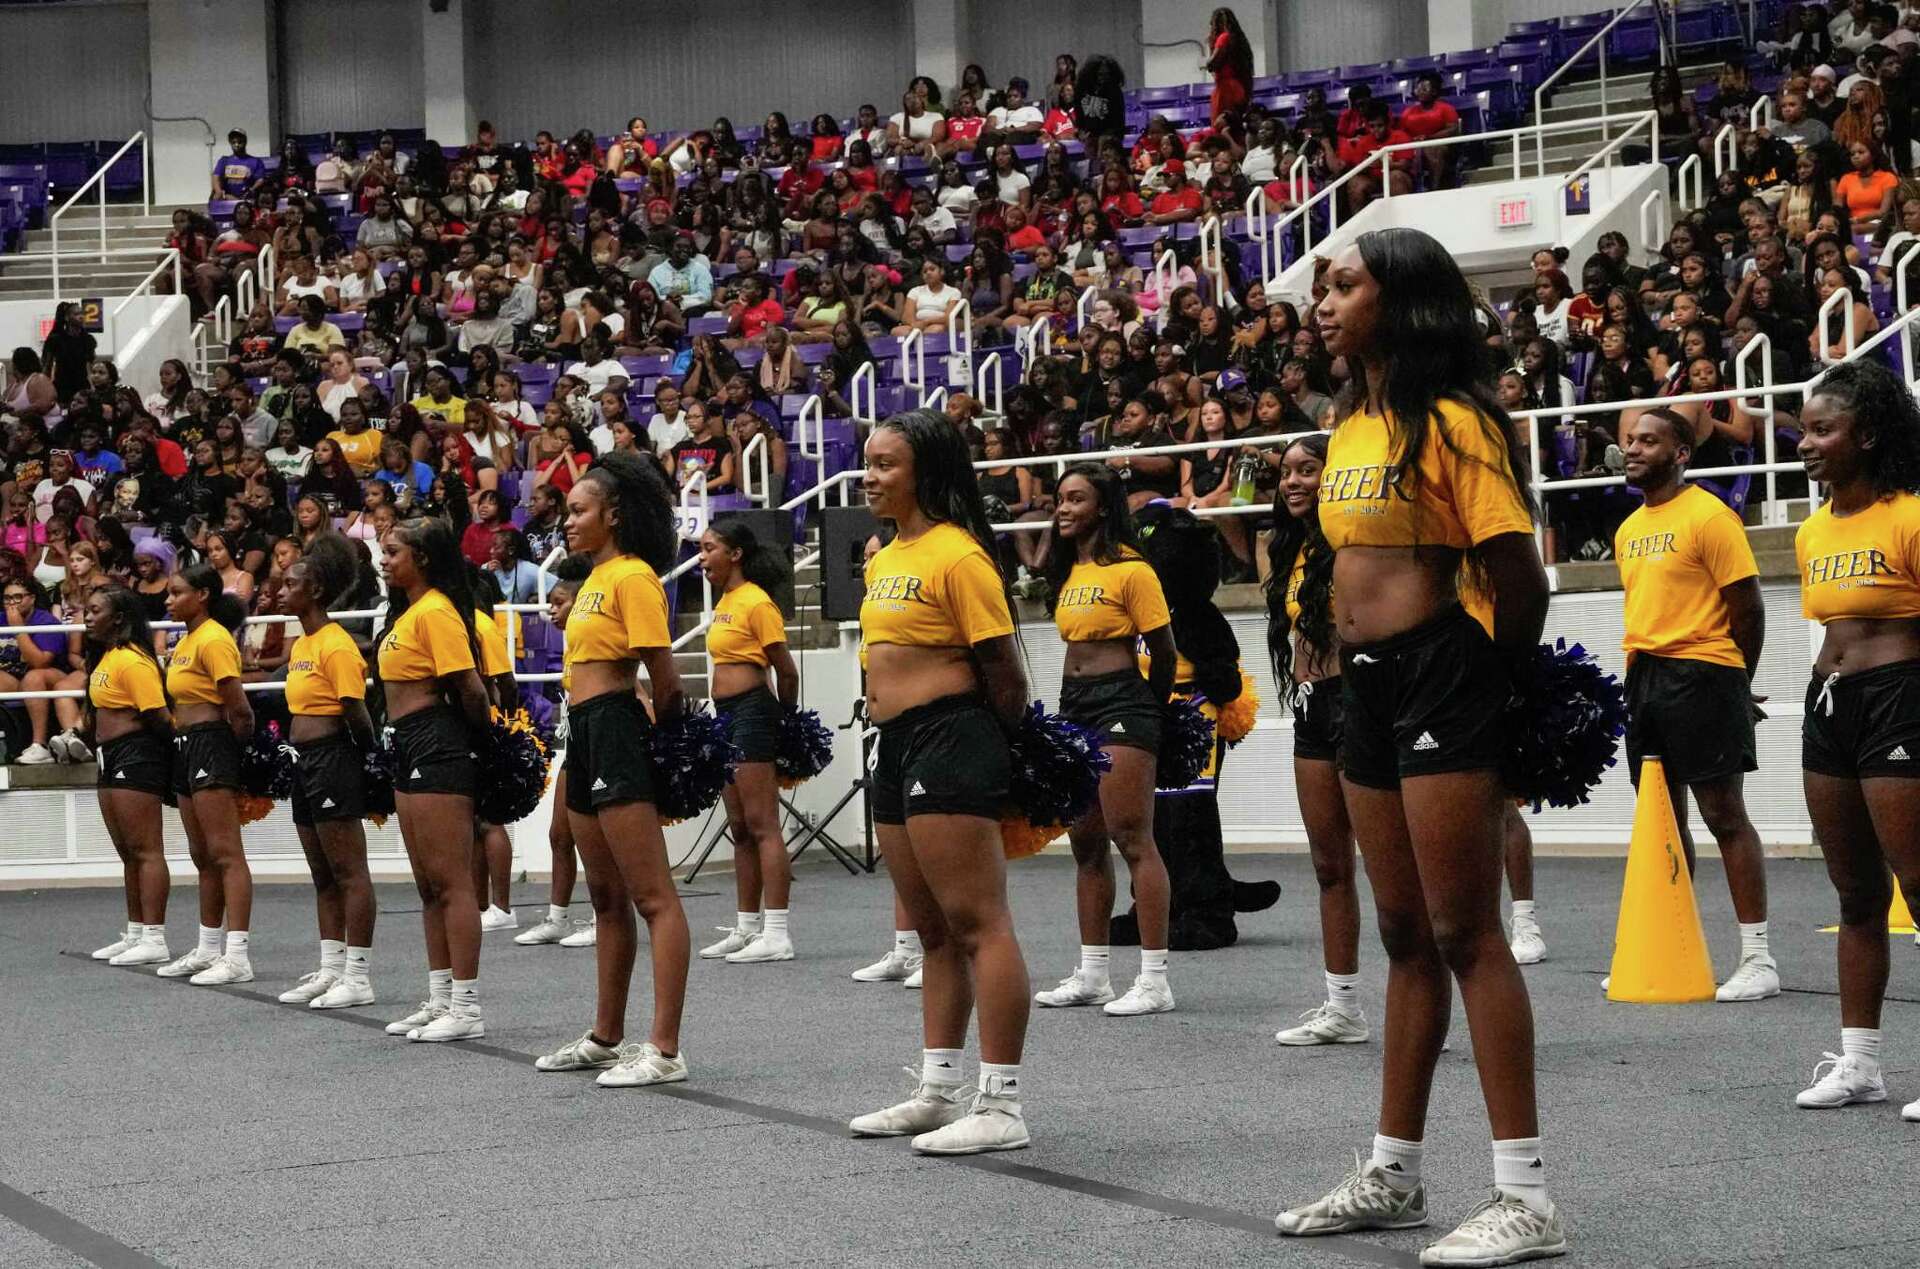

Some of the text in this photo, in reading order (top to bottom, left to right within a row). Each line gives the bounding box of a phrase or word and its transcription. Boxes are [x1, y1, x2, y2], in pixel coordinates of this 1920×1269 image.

[1499, 200, 1527, 225] EXIT
[84, 303, 99, 323] 2
[1318, 464, 1416, 503] HEER
[1620, 532, 1680, 560] HEER
[1807, 547, 1898, 586] HEER
[865, 575, 929, 605] HEER
